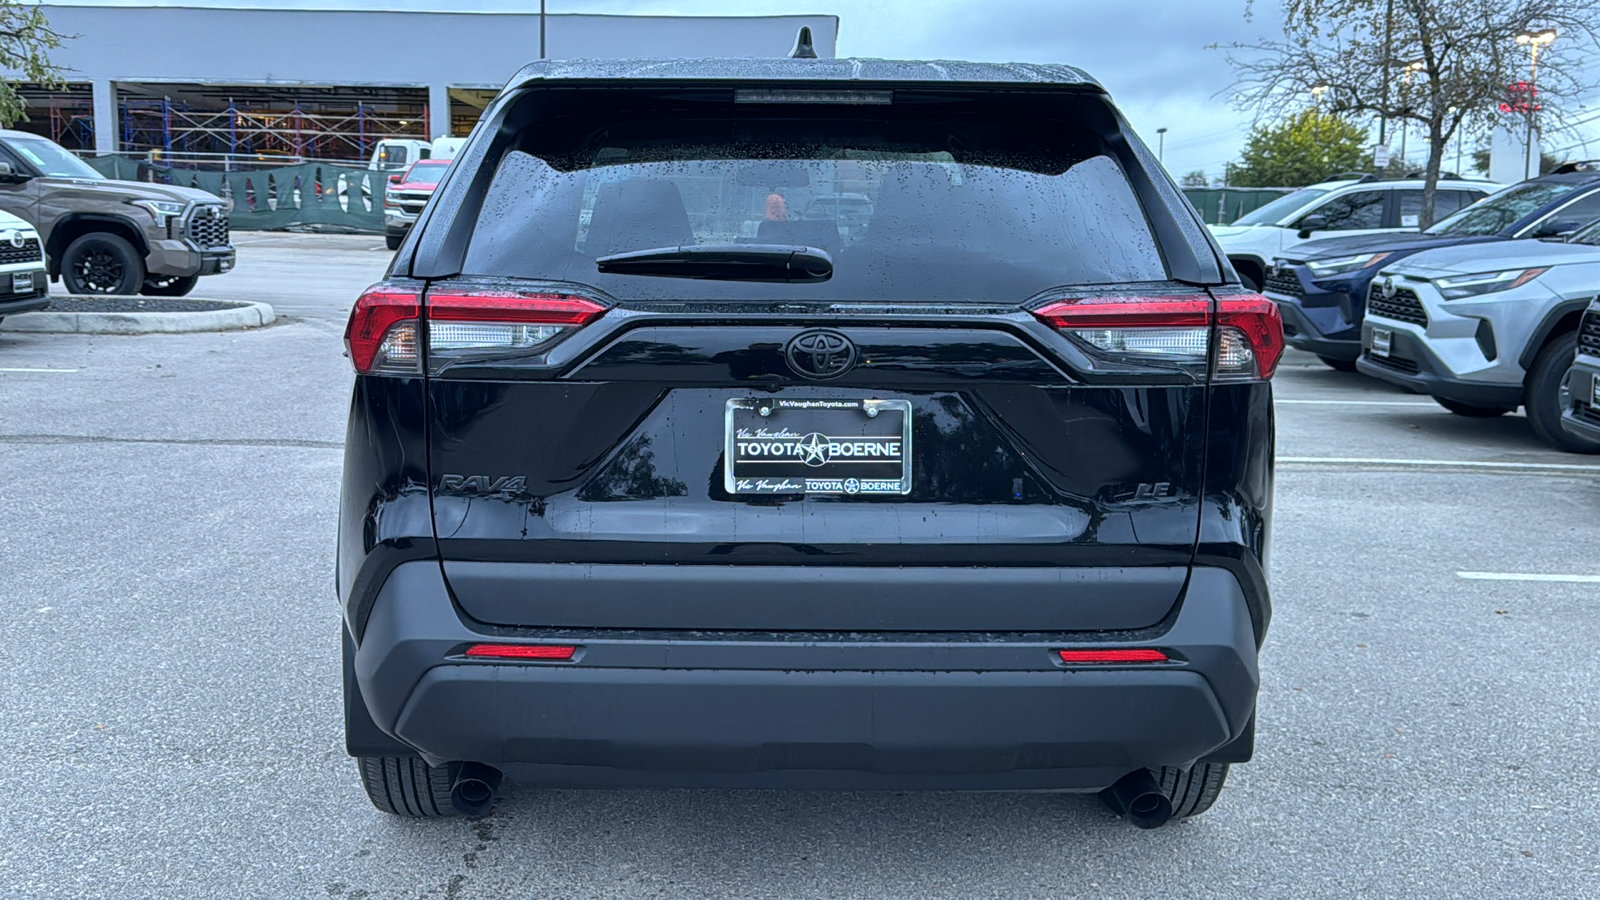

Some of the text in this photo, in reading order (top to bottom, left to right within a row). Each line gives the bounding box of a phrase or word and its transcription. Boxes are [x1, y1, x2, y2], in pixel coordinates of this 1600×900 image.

[778, 400, 859, 408] VicVaughanToyota.com
[737, 442, 805, 456] TOYOTA
[828, 442, 901, 456] BOERNE
[439, 474, 528, 493] RAV4
[805, 481, 843, 490] TOYOTA
[860, 482, 901, 490] BOERNE
[1135, 482, 1171, 498] LE
